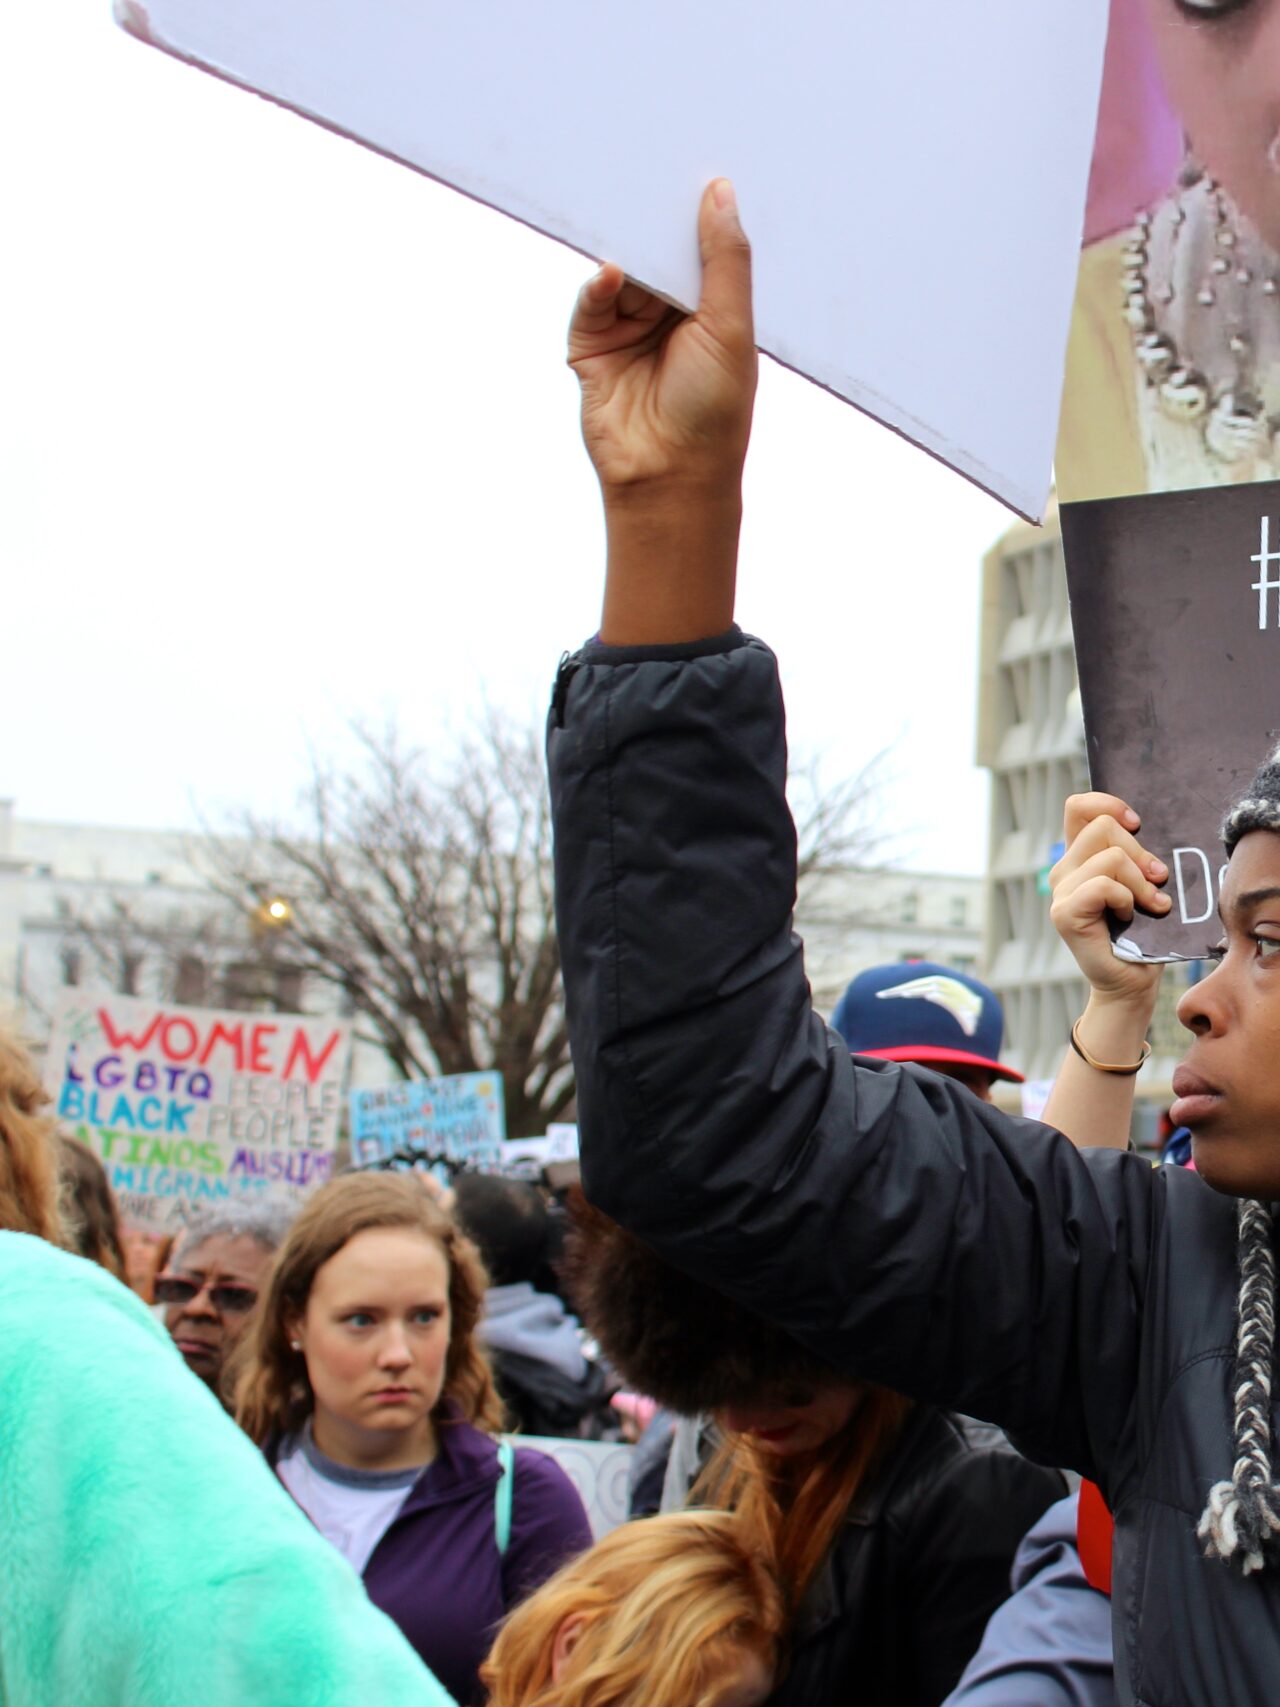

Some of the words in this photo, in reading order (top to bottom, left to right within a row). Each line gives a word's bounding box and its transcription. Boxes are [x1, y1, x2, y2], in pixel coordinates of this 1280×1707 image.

[66, 1043, 214, 1101] LGBTQ
[228, 1076, 338, 1114] PEOPLE
[96, 1007, 342, 1084] WOMEN
[57, 1080, 196, 1133] BLACK
[206, 1104, 326, 1150] PEOPLE
[74, 1125, 226, 1176] ATINOS
